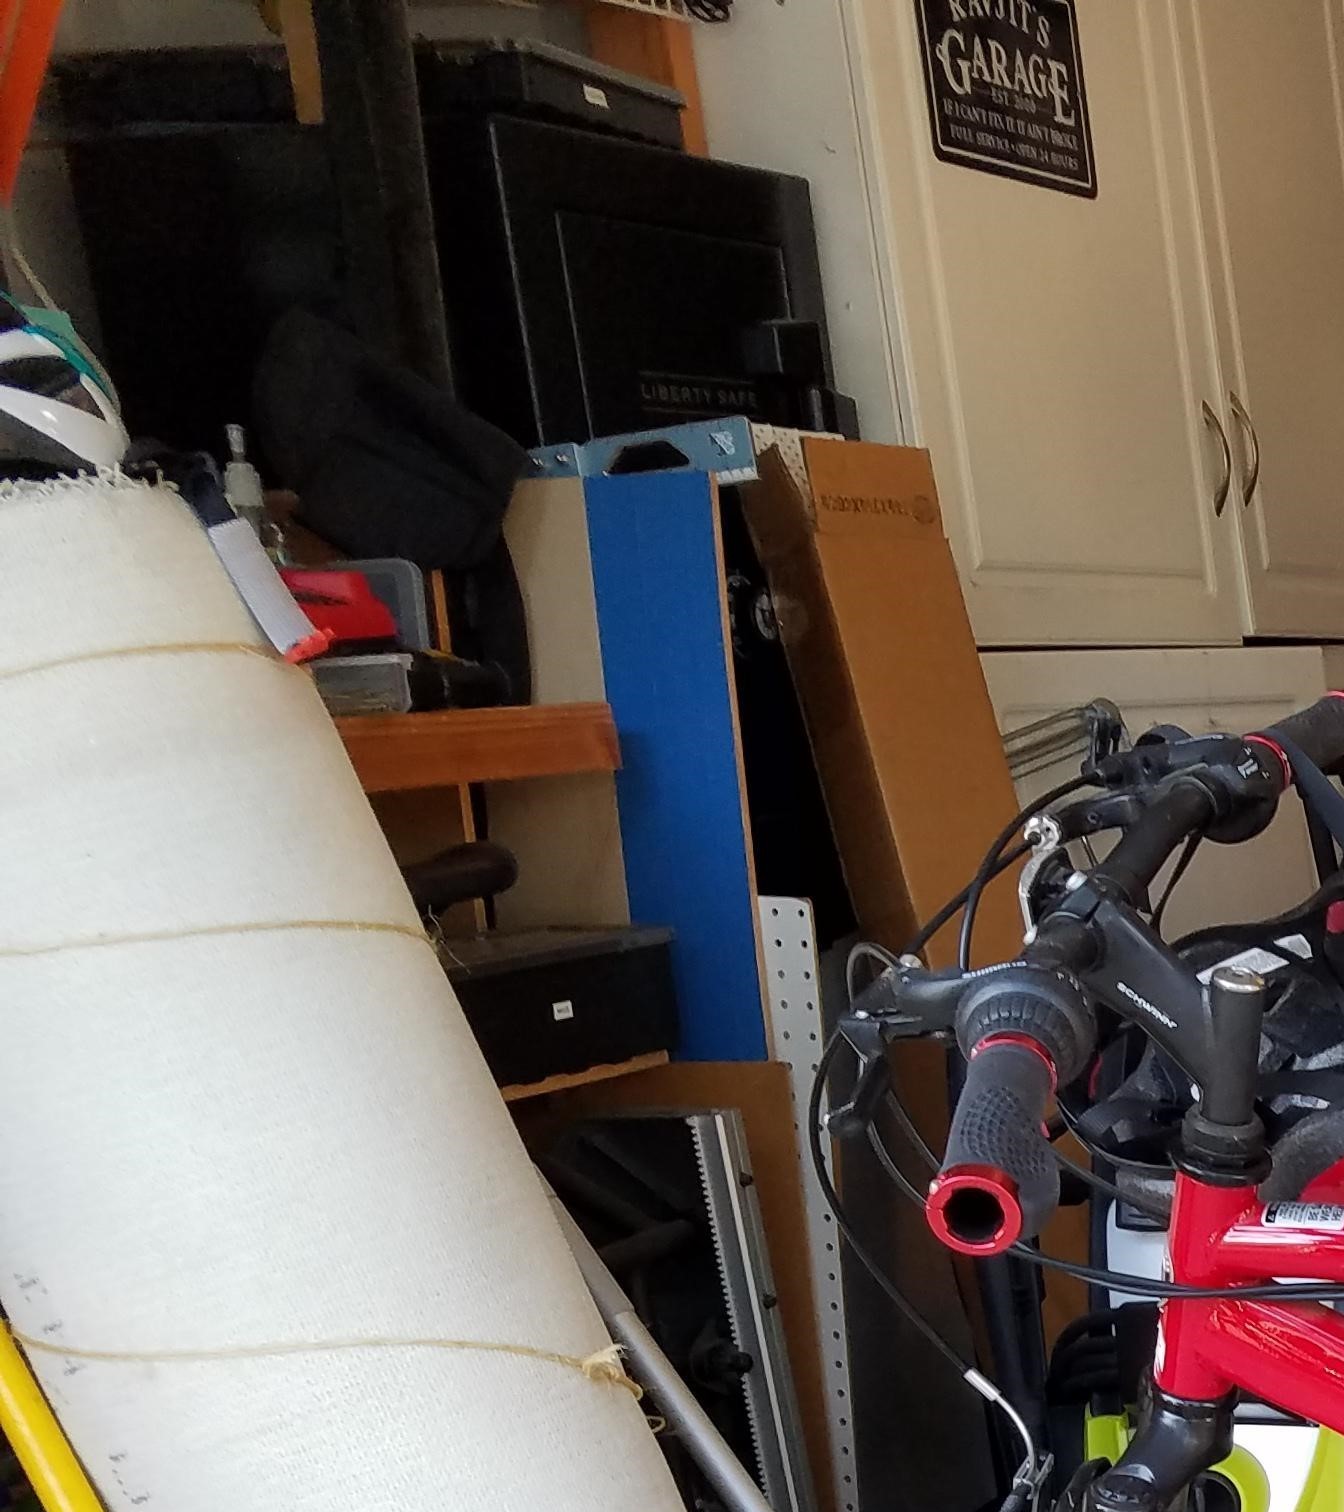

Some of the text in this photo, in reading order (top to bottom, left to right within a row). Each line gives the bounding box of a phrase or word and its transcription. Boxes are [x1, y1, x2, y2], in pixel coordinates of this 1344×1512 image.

[936, 29, 1075, 126] GARAGE
[641, 383, 758, 409] LIBERTY SAFE
[1116, 981, 1179, 1029] SCHWINN
